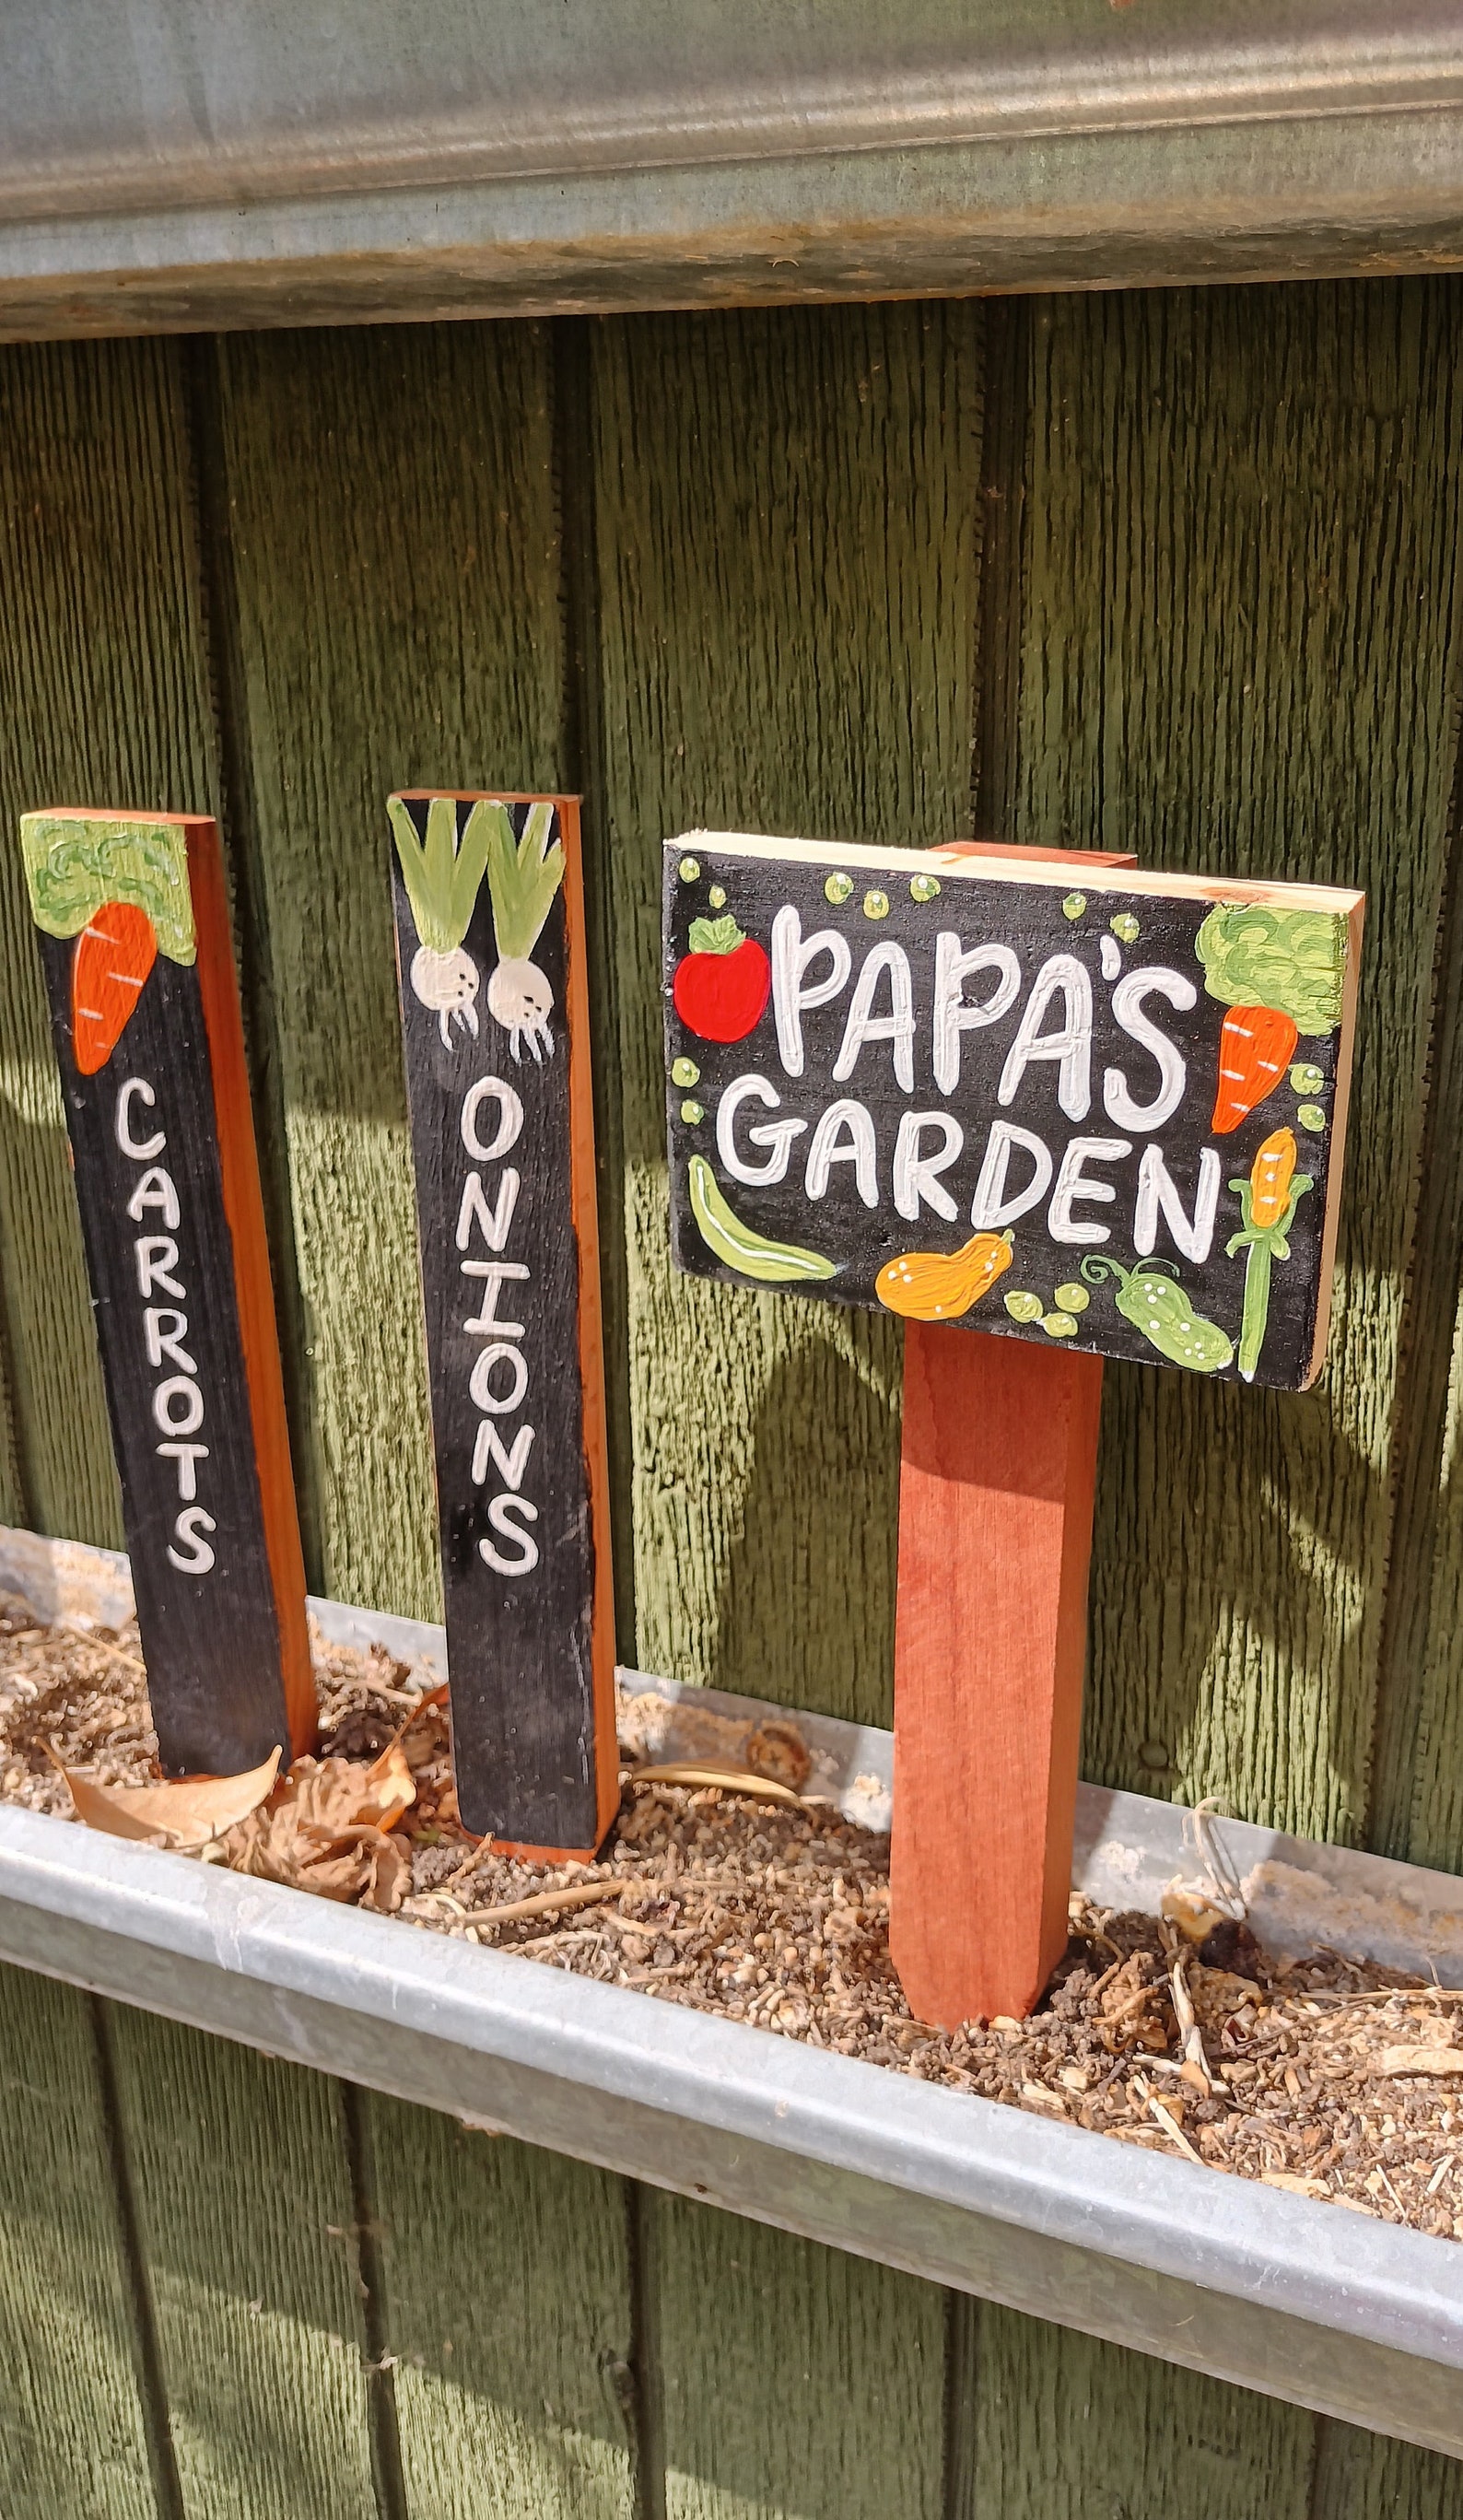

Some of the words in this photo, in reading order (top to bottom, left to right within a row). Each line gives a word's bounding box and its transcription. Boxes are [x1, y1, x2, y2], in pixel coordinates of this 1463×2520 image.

[716, 1073, 1222, 1264] GARDEN
[771, 904, 1198, 1133] PAPA'S
[115, 1076, 217, 1576] CARROTS
[455, 1074, 540, 1577] ONIONS
